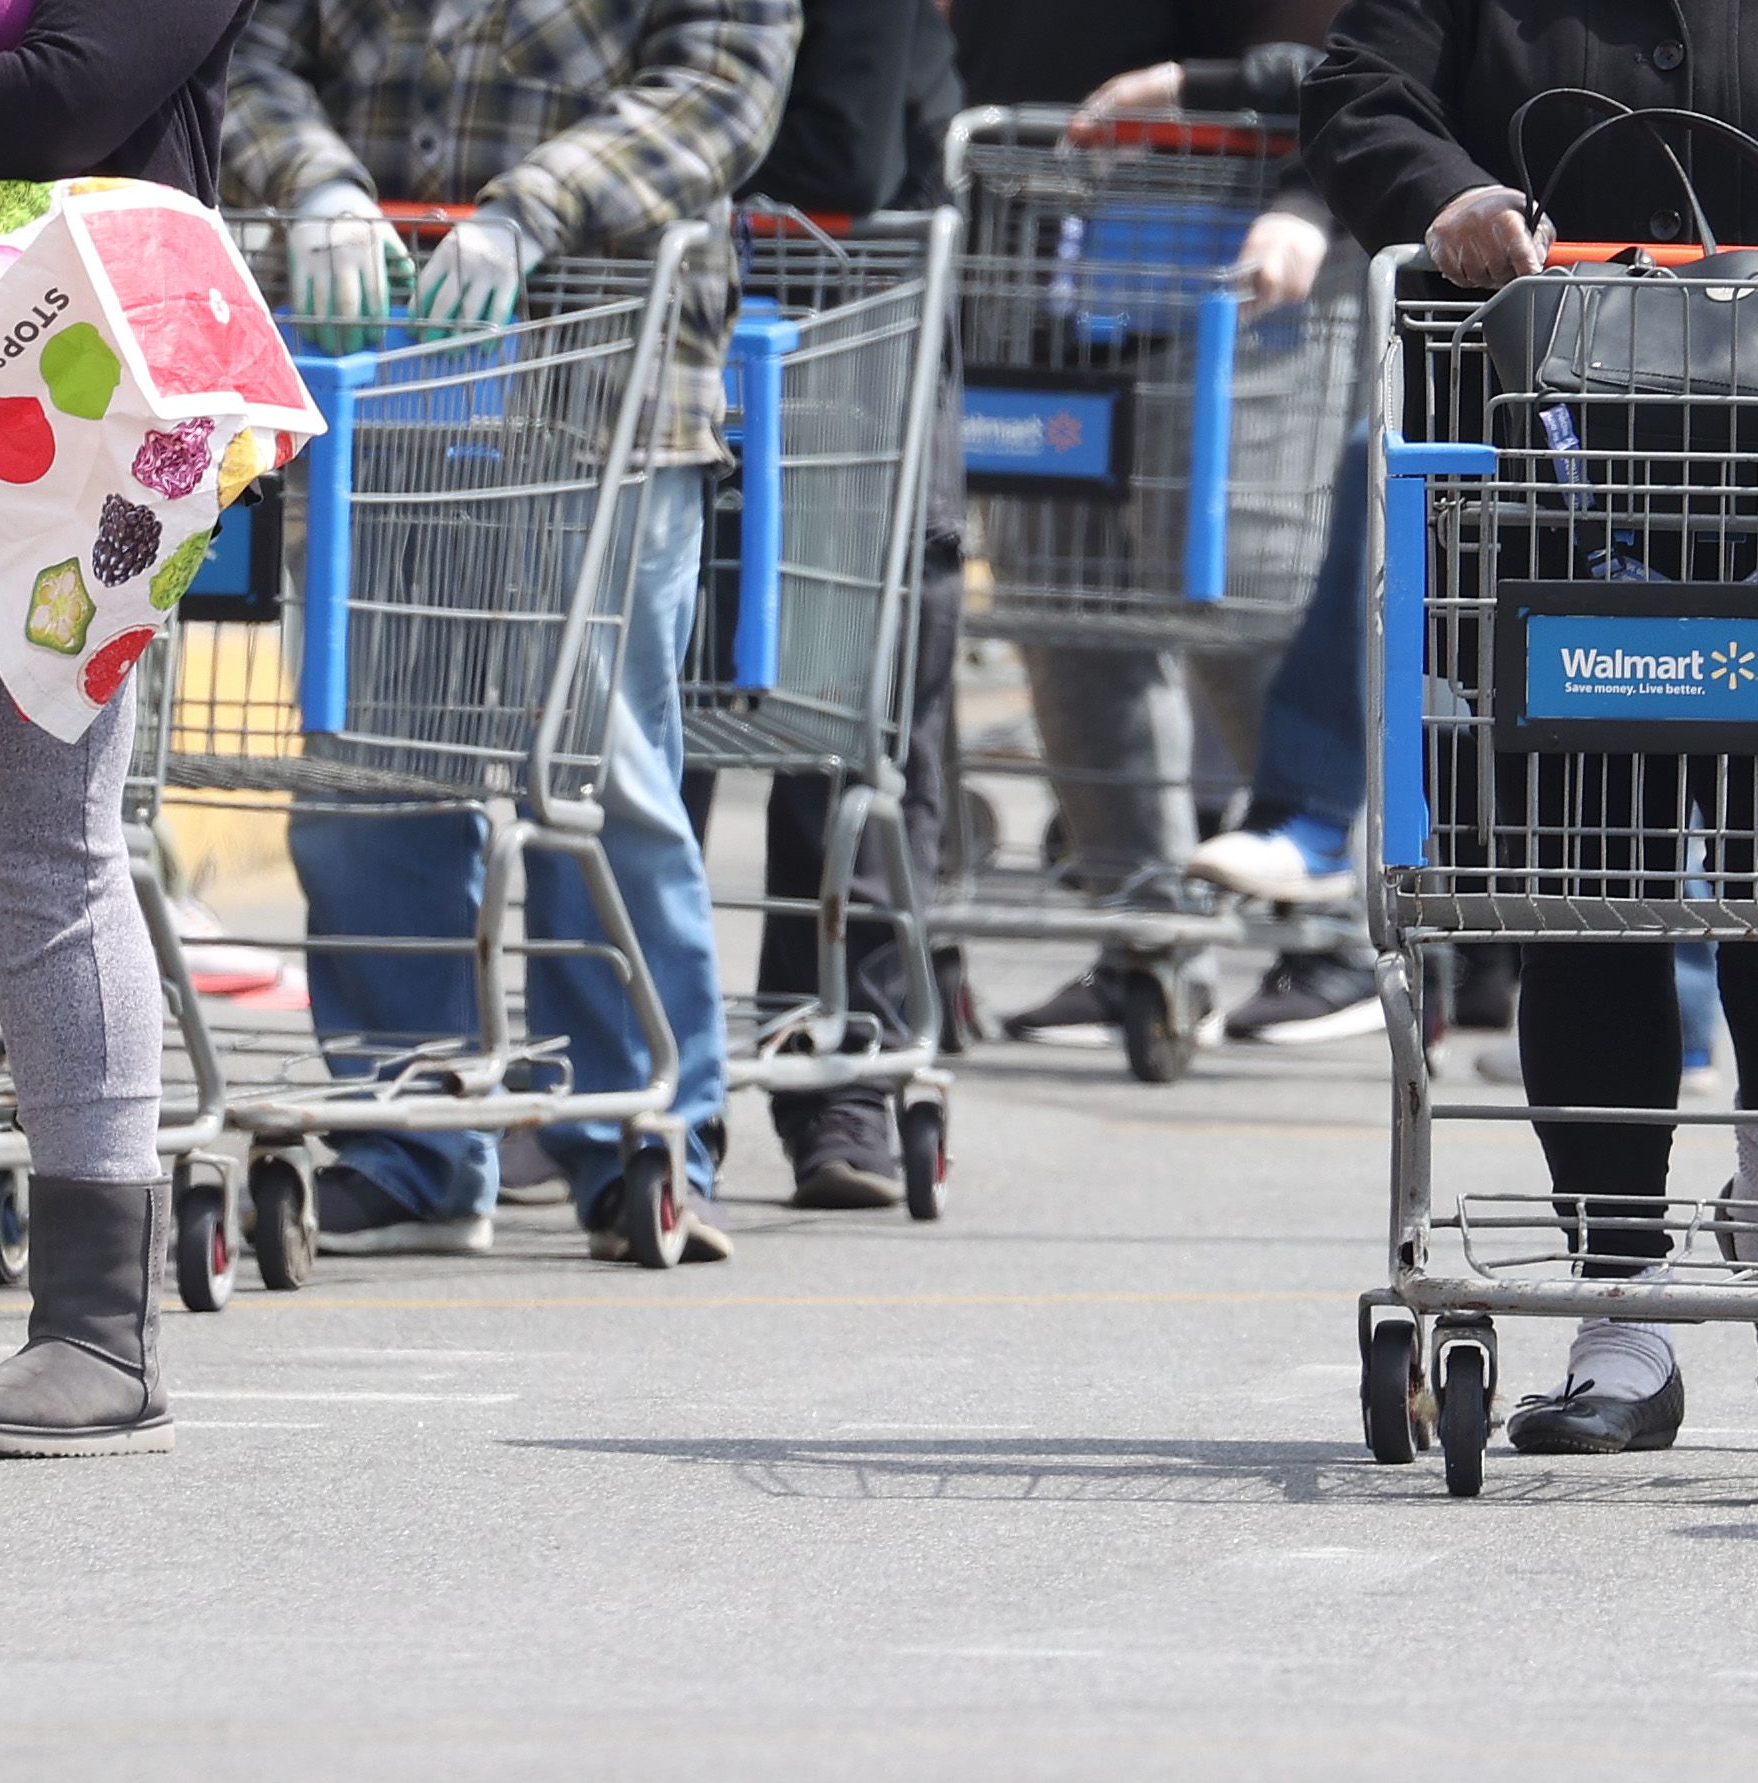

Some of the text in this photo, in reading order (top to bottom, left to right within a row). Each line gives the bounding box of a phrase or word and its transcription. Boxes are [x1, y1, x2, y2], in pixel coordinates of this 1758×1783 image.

[1560, 648, 1705, 681] Walmart
[1564, 681, 1706, 697] Save money. Live better.
